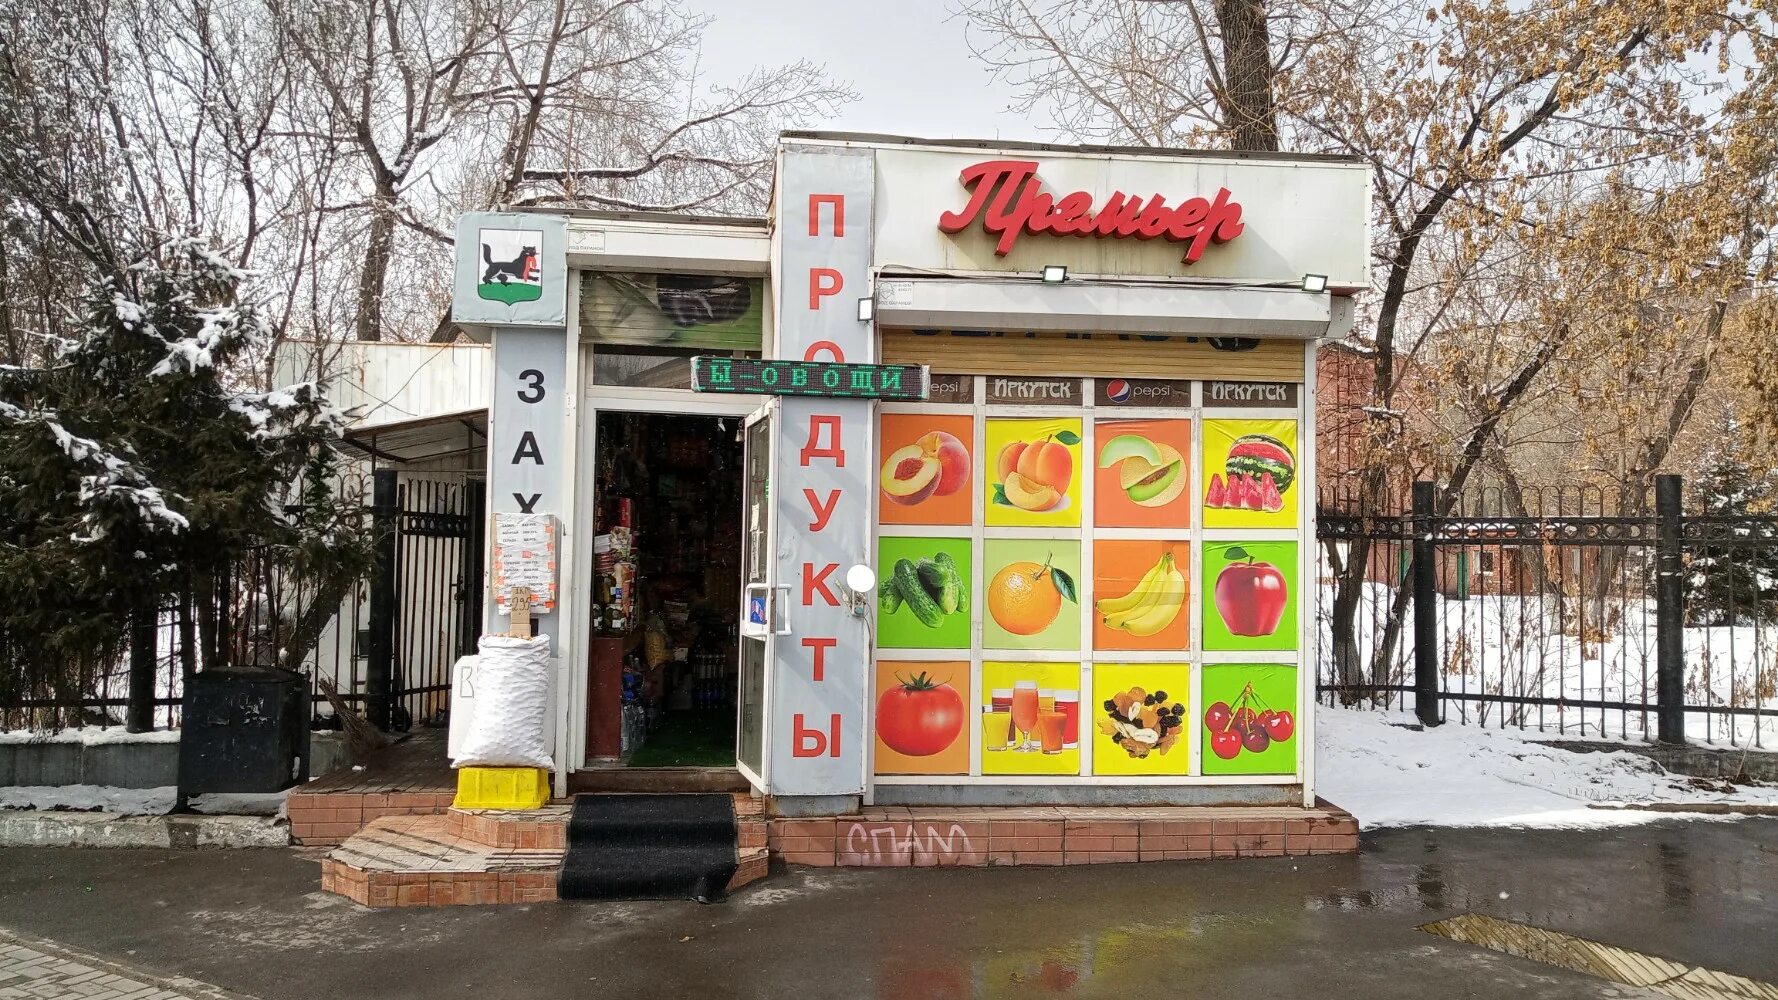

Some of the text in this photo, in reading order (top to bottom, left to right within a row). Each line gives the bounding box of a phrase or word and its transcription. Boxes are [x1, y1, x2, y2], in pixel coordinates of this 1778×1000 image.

[938, 159, 1245, 264] Премьер
[930, 381, 959, 395] epsi
[994, 378, 1071, 398] ИРКУТСК
[1133, 385, 1171, 397] pepsi
[1211, 381, 1287, 401] ИРКУТСК
[847, 823, 976, 864] СПАМ
